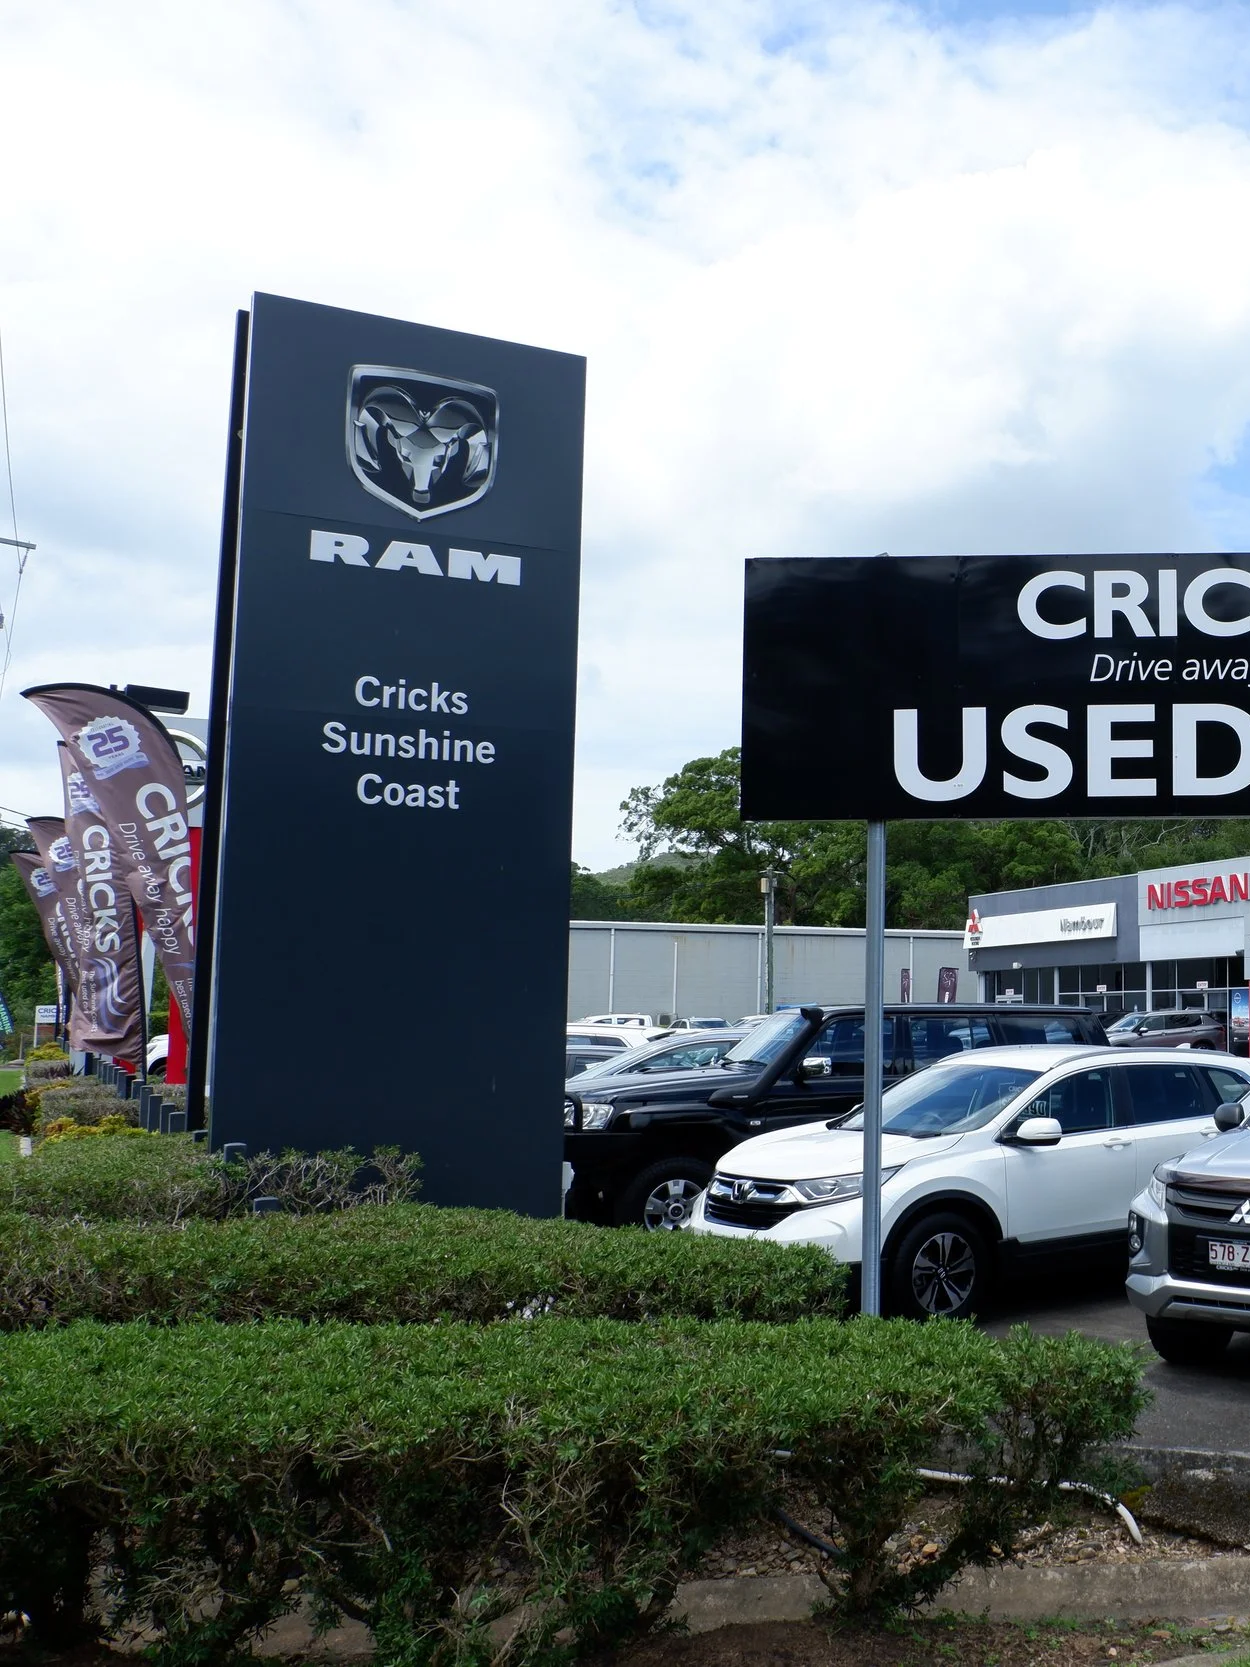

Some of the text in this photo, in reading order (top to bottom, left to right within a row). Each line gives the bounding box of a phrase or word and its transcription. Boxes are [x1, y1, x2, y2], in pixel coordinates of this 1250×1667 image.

[309, 529, 522, 586] RAM
[1090, 652, 1173, 683] Drive
[354, 674, 469, 715] Cricks
[87, 725, 130, 758] 25
[321, 721, 496, 765] Sunshine
[356, 773, 460, 810] Coast
[136, 782, 194, 947] CRIC
[82, 825, 120, 953] CRICKS
[118, 822, 182, 955] Drive away happy
[1147, 872, 1249, 910] NISSAN
[65, 897, 80, 920] Drive
[174, 979, 188, 998] best
